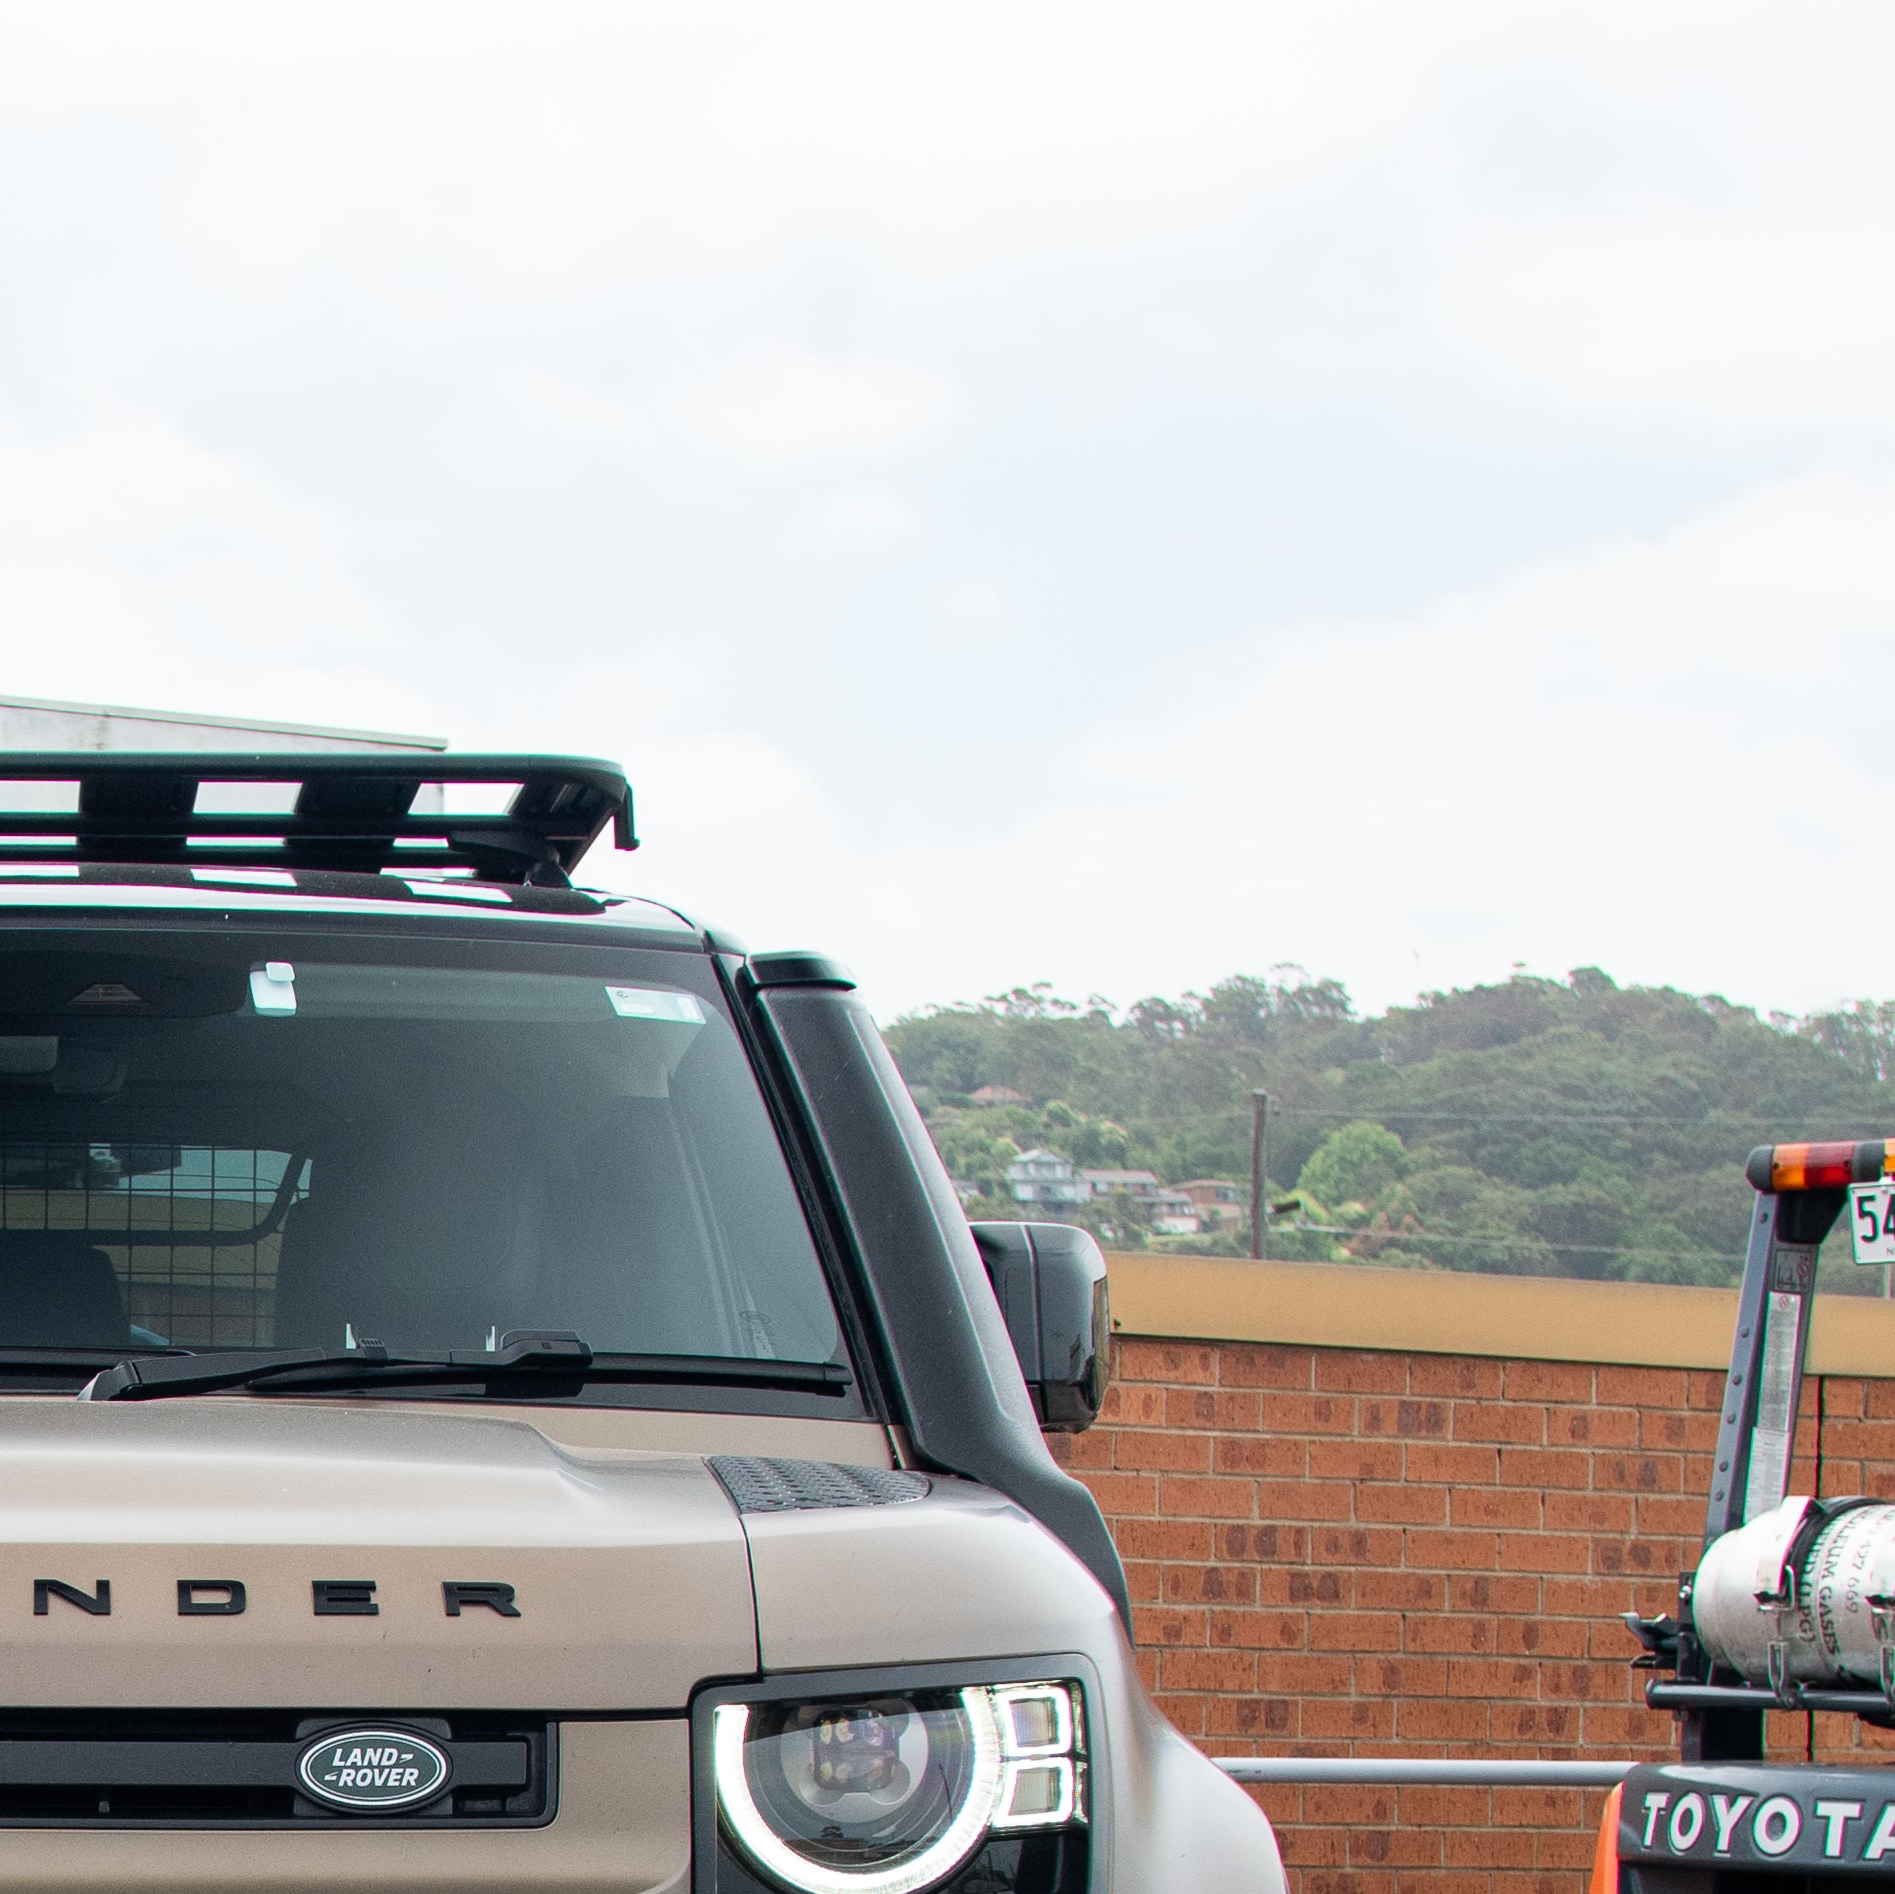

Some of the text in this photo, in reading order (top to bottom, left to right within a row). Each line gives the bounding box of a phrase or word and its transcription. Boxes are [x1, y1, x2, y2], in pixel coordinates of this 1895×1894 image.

[1818, 1586, 1842, 1657] GASES
[331, 1748, 399, 1767] LAND
[338, 1768, 420, 1787] ROVER
